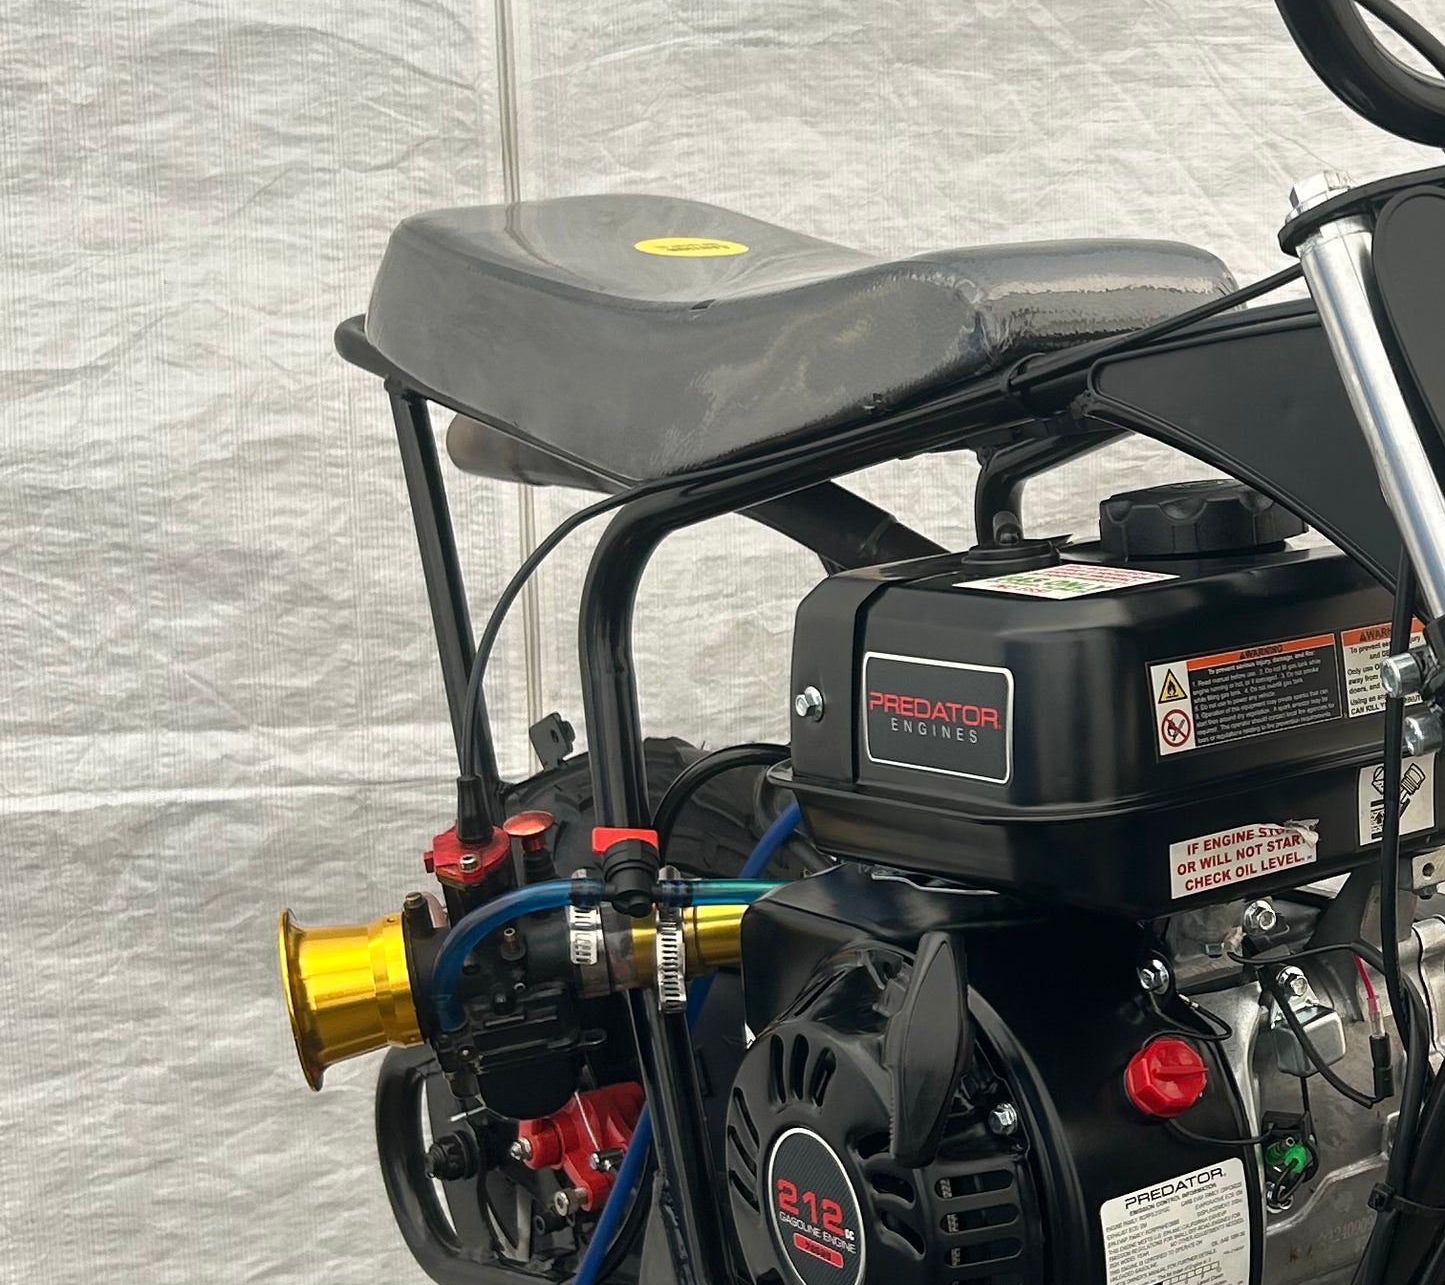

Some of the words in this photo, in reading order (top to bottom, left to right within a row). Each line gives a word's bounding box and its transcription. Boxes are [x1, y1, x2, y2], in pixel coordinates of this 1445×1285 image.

[869, 691, 1000, 730] PREDATOR
[891, 717, 978, 743] ENGINES
[1187, 842, 1199, 856] IF
[1203, 829, 1254, 852] ENGINE
[1177, 861, 1196, 876] OR
[1200, 853, 1232, 870] WILL
[1236, 844, 1263, 860] NOT
[1185, 869, 1231, 891] CHECK
[1235, 864, 1258, 878] OIL
[1125, 1167, 1223, 1209] PREDATOR
[779, 1211, 822, 1239] GASOLINE
[822, 1231, 857, 1255] ENGINE
